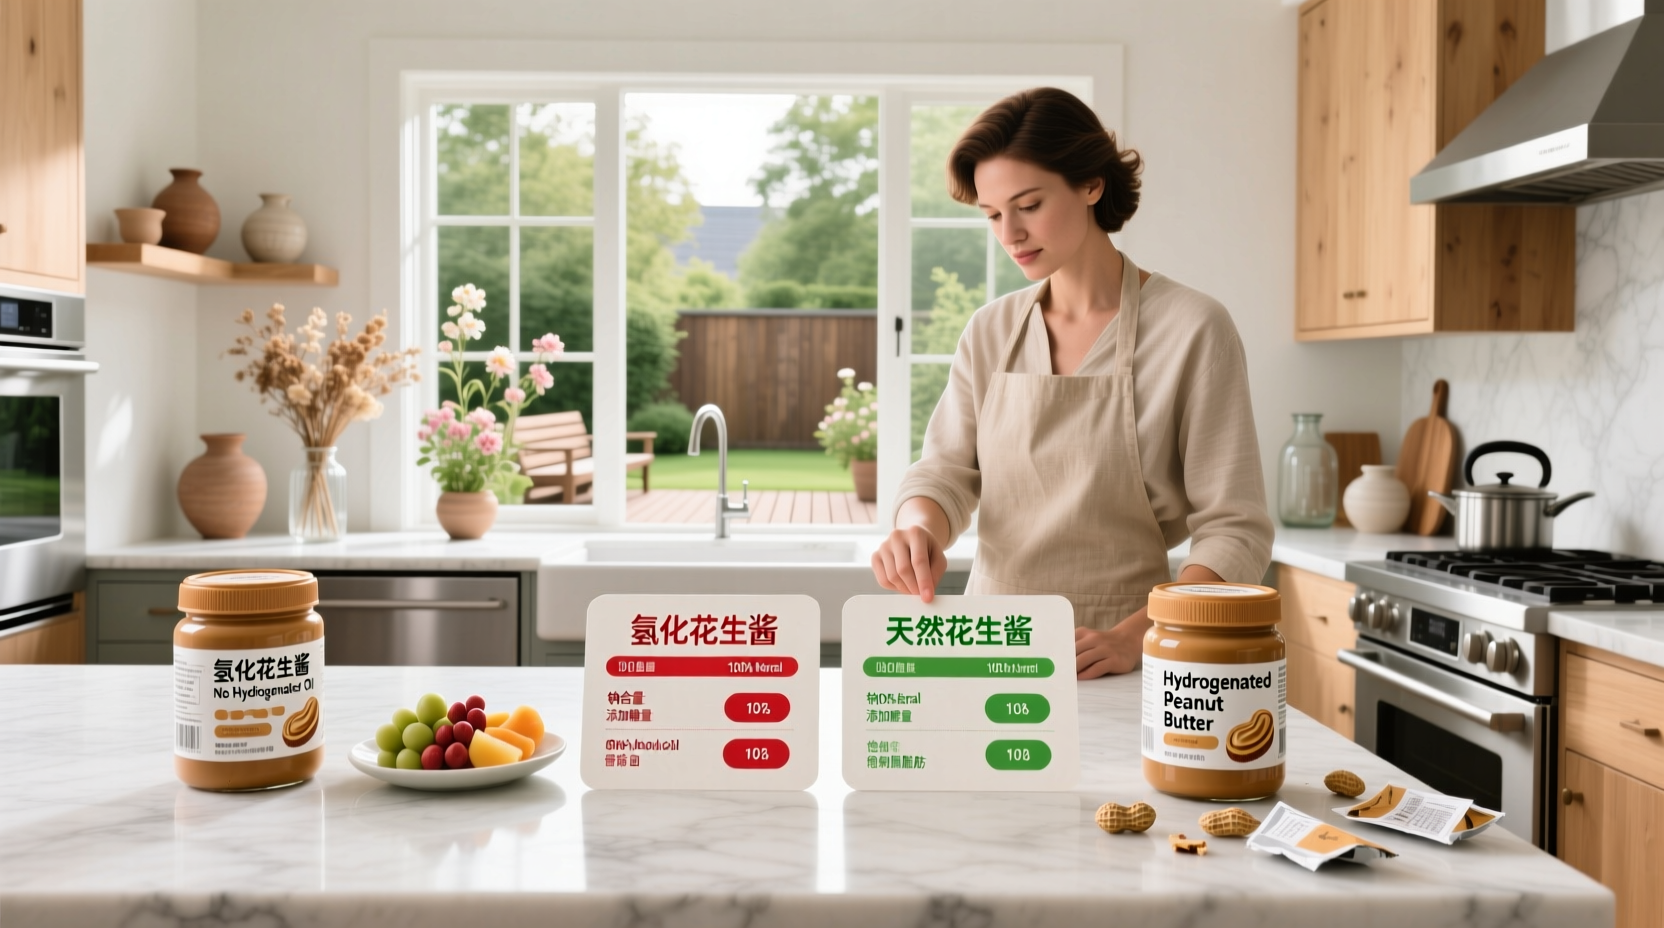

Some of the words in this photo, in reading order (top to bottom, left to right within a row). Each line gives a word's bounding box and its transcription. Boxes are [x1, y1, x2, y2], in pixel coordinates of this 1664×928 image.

[631, 613, 778, 646] 氢化花生酱
[886, 614, 1033, 646] 天然花生酱
[213, 652, 310, 683] 氢化花生酱
[213, 687, 230, 698] No
[1163, 670, 1272, 695] Hydrogenated
[1164, 691, 1224, 712] Peanut
[1164, 711, 1214, 731] Butter
